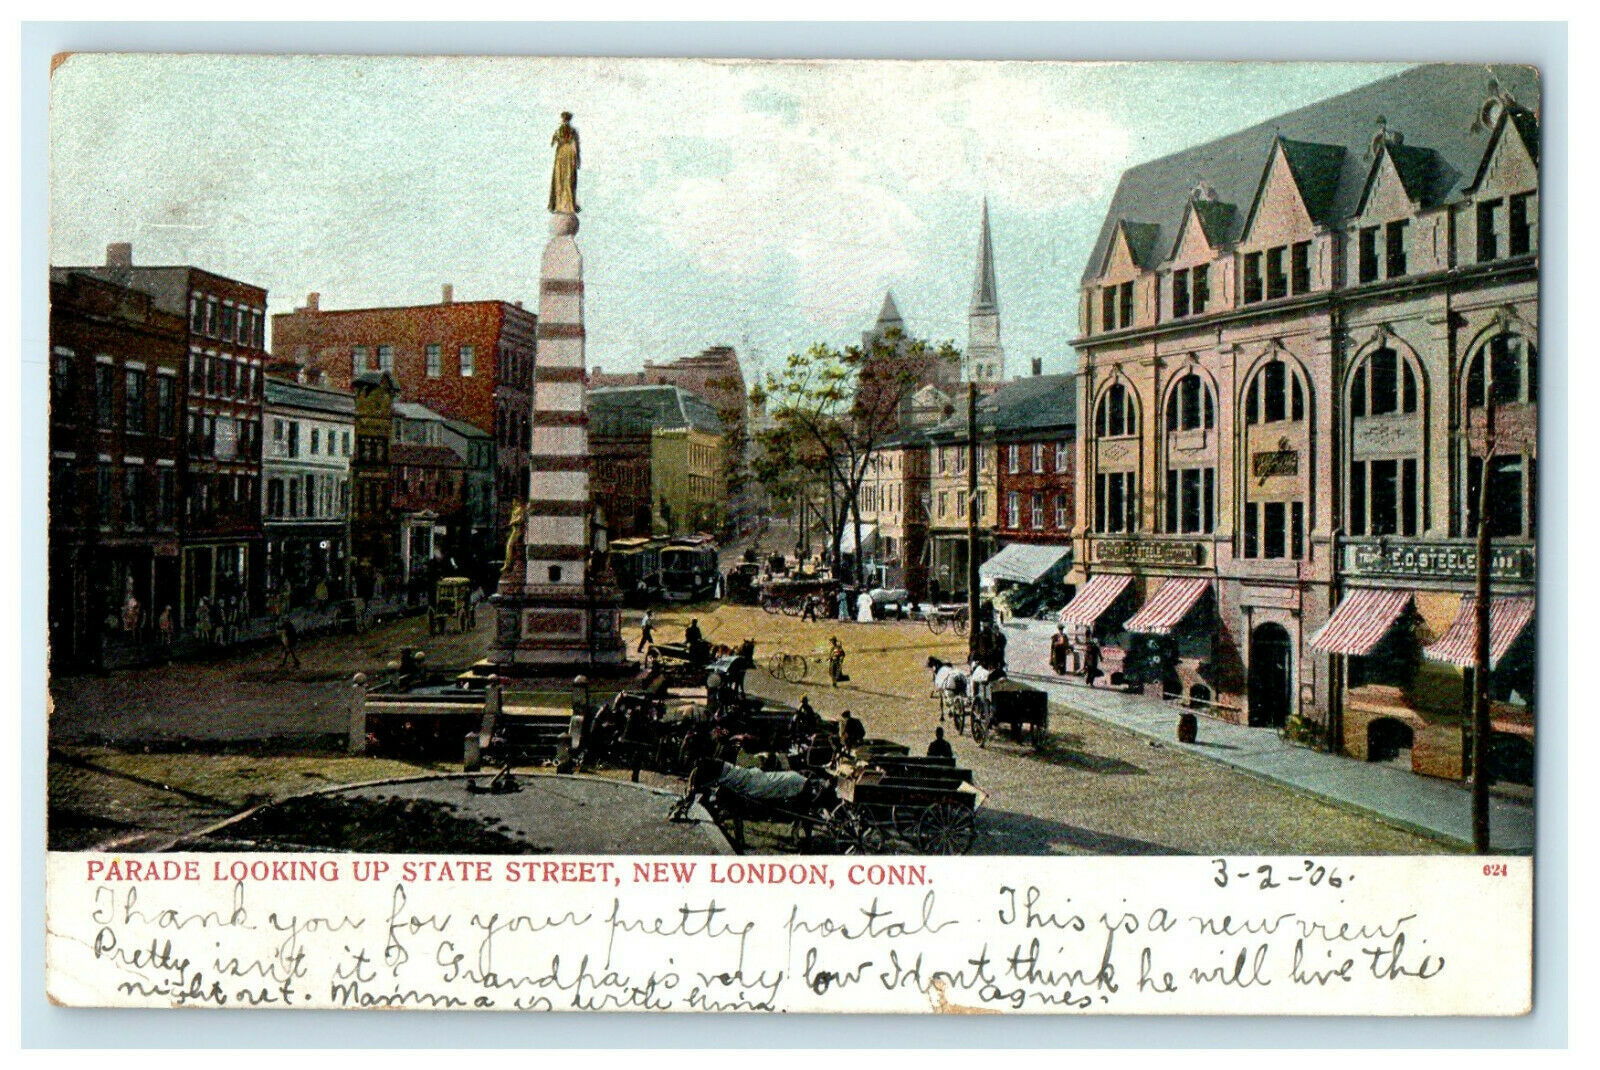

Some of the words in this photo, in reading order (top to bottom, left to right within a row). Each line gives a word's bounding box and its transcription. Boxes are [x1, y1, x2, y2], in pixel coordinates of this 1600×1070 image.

[87, 861, 200, 881] PARADE
[213, 861, 339, 881] LOOKING
[353, 862, 389, 881] UP
[403, 862, 493, 882] STATE
[506, 862, 621, 887] STREET,
[633, 863, 697, 883] NEW
[710, 864, 835, 888] LONDON,
[847, 865, 933, 885] CONN.
[1483, 864, 1507, 876] 624
[92, 880, 256, 930] Thank
[268, 912, 366, 975] you
[386, 883, 451, 966] for
[470, 911, 593, 976] your
[605, 897, 755, 970] pretty
[998, 885, 1086, 932] This
[1099, 897, 1139, 933] is
[1147, 907, 1177, 932] a
[1189, 913, 1296, 935] new
[94, 926, 190, 985] Pretty
[436, 940, 629, 1000] Grandpa
[696, 970, 785, 1005] very
[802, 946, 873, 995] low
[1004, 937, 1119, 993] think
[1138, 947, 1178, 993] he
[1189, 943, 1272, 988] will
[1289, 938, 1354, 987] live
[571, 982, 672, 1011] with
